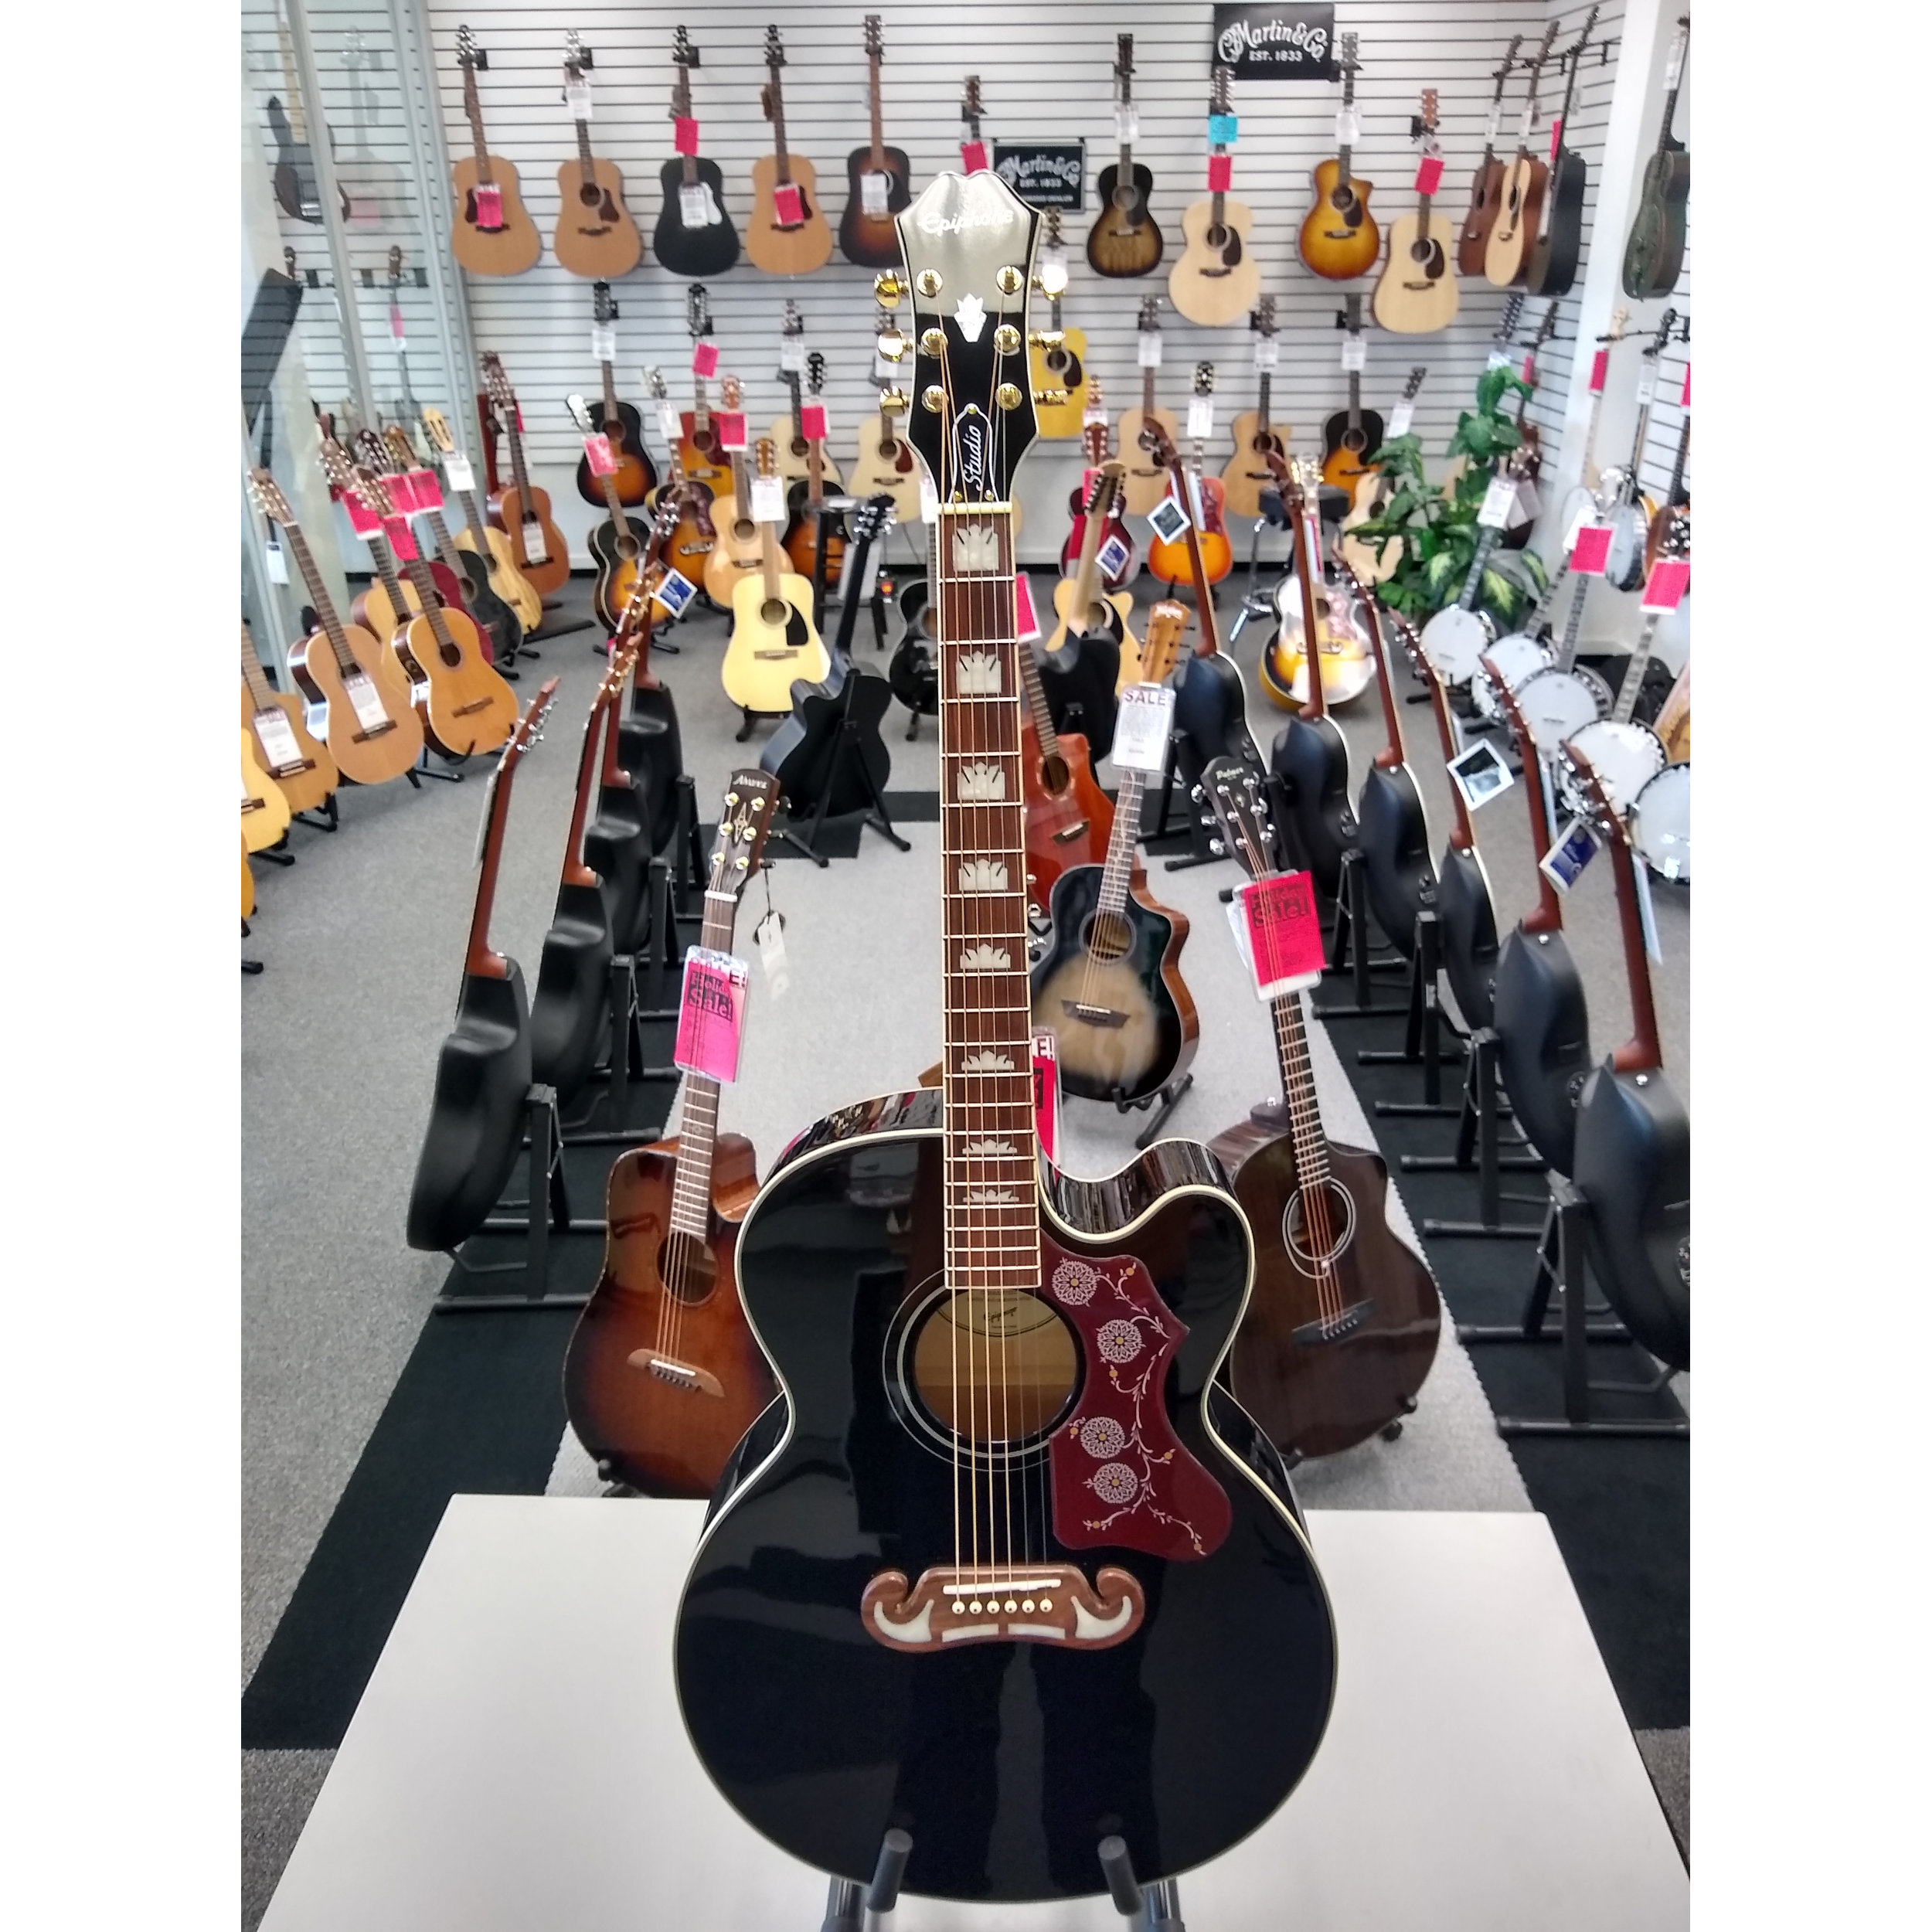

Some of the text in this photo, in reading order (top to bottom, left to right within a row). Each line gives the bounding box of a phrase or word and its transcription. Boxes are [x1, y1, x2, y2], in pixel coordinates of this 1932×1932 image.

[917, 209, 1014, 236] Epiphone
[962, 424, 982, 492] Studio
[1124, 689, 1167, 706] SALE
[689, 986, 733, 1021] Sale!
